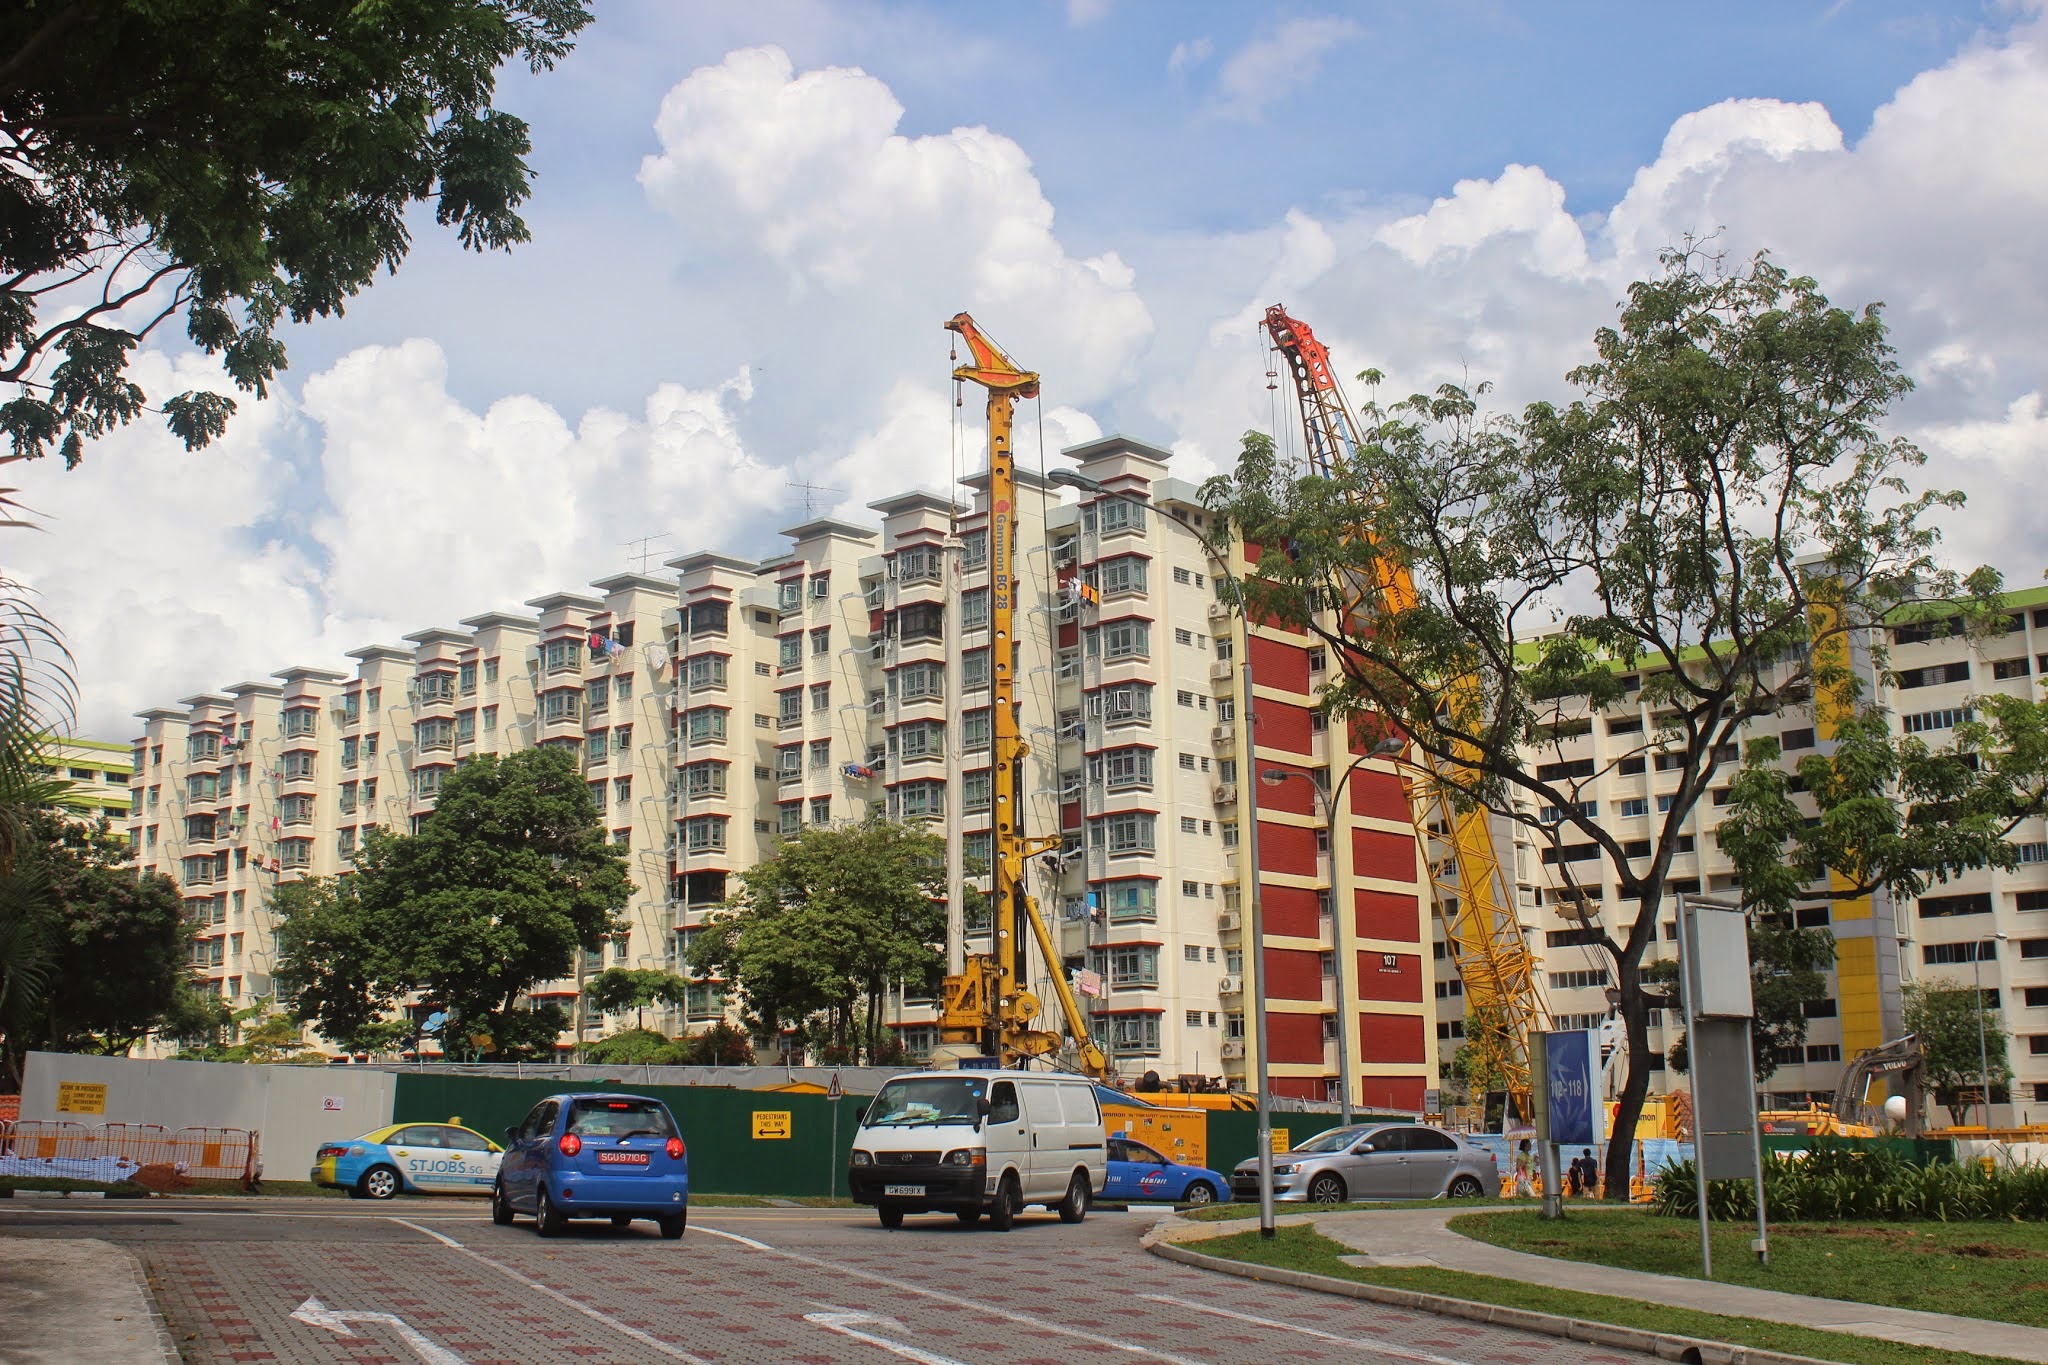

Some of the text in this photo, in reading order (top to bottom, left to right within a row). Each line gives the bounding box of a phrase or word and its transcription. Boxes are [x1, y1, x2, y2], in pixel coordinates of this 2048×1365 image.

[996, 514, 1007, 610] Gammon BG 28
[1383, 954, 1396, 966] 107
[1883, 1061, 1907, 1070] VOLVO
[1140, 1176, 1167, 1184] Comfort
